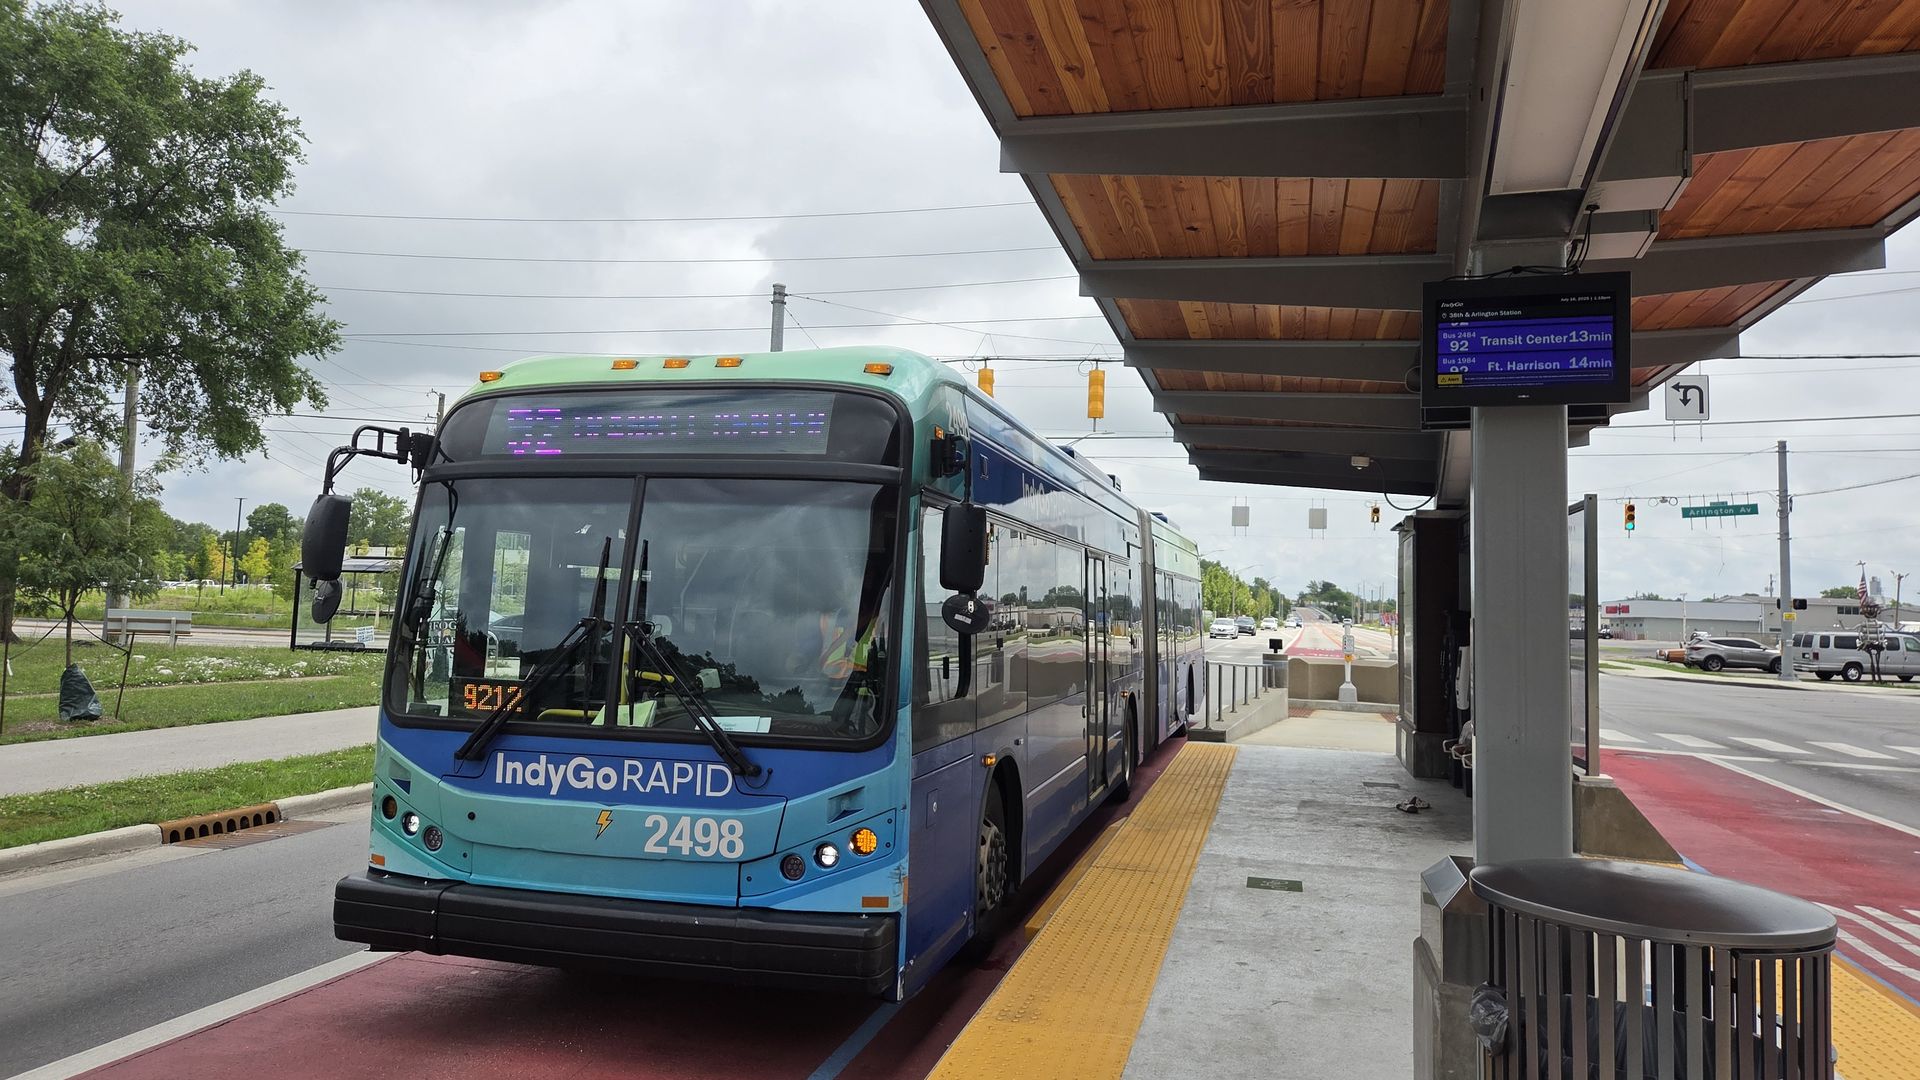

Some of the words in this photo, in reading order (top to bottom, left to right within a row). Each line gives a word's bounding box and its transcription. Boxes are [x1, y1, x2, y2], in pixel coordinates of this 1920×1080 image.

[1450, 340, 1469, 352] 92
[1480, 335, 1523, 347] Transit
[1527, 333, 1568, 345] Center
[1443, 357, 1456, 365] Bus
[1457, 356, 1476, 364] 1984
[1487, 362, 1504, 372] Ft.
[1507, 360, 1560, 371] Harrison
[1689, 508, 1734, 517] Arlington
[495, 752, 618, 795] IndyGo
[622, 760, 733, 798] RAPID
[643, 814, 745, 859] 2498
